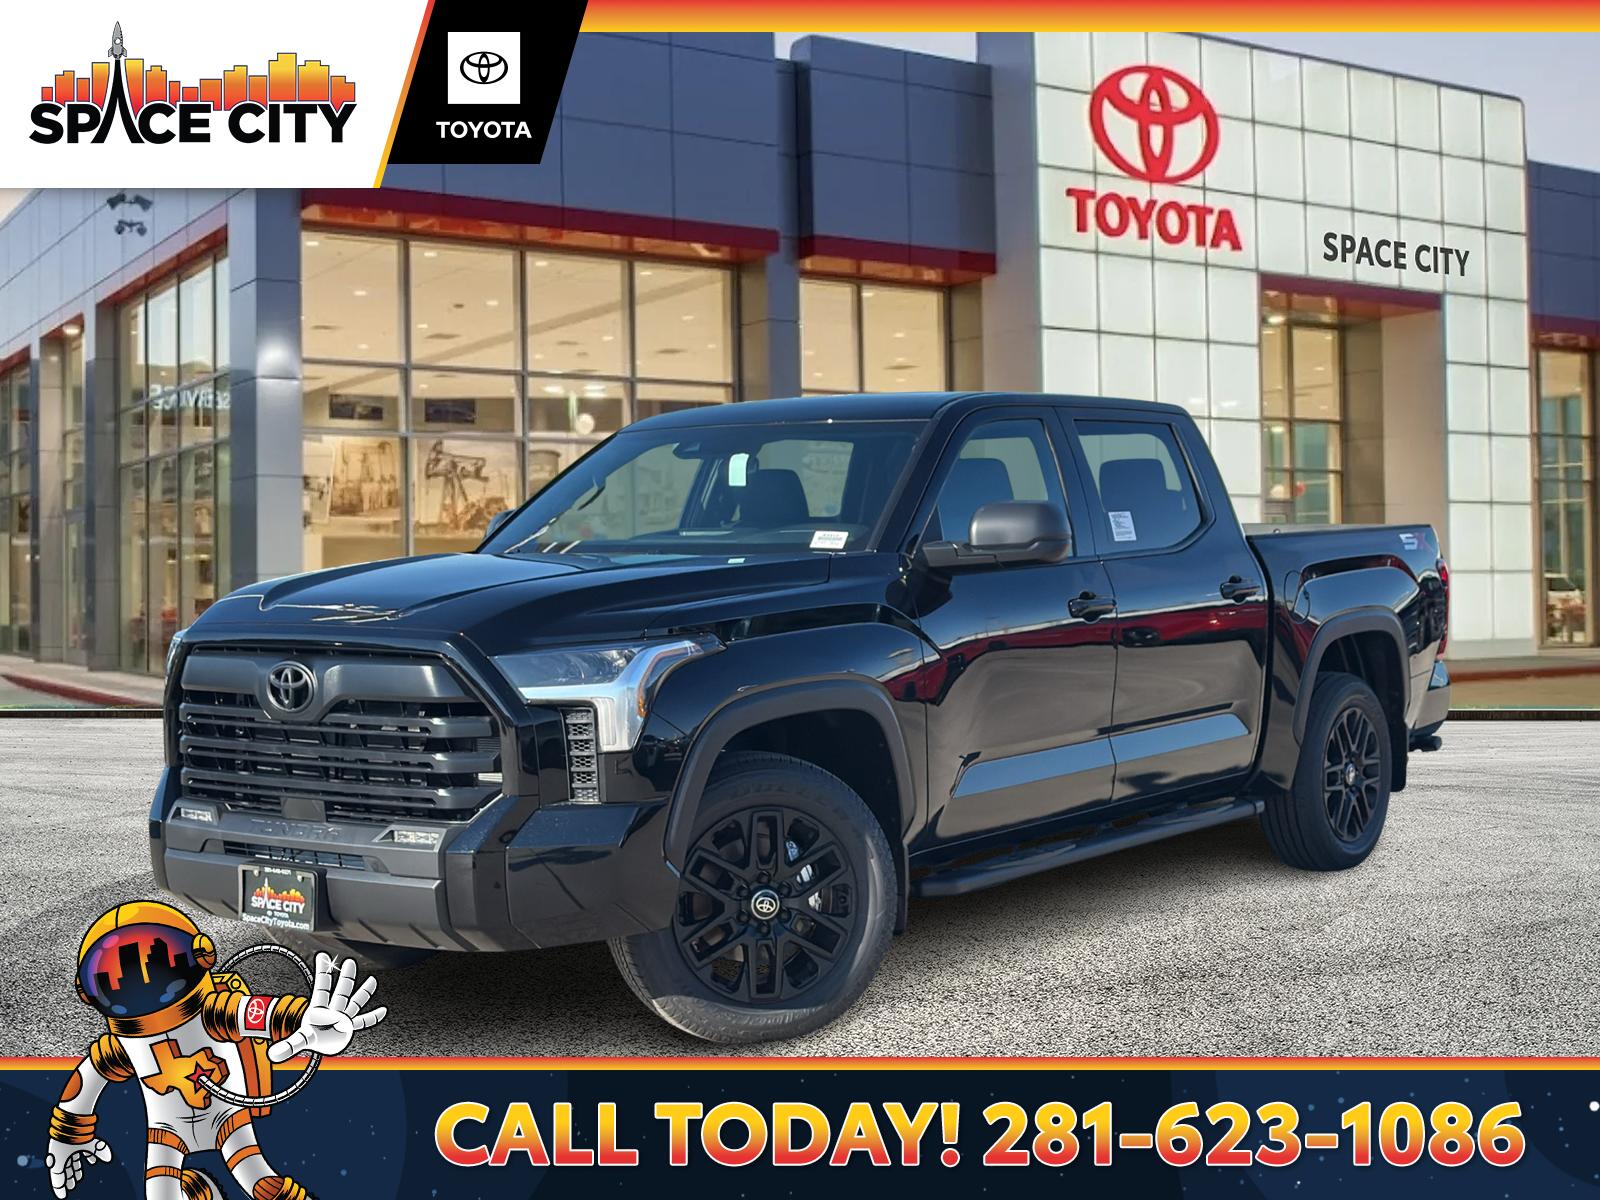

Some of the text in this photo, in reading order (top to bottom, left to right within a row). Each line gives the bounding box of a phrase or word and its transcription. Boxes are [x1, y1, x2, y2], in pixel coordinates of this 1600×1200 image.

[1066, 187, 1243, 251] TOYOTA
[1322, 232, 1471, 277] SPACE CITY
[251, 893, 305, 914] SPACE CITY
[242, 912, 310, 930] SpaceCityToyota.com
